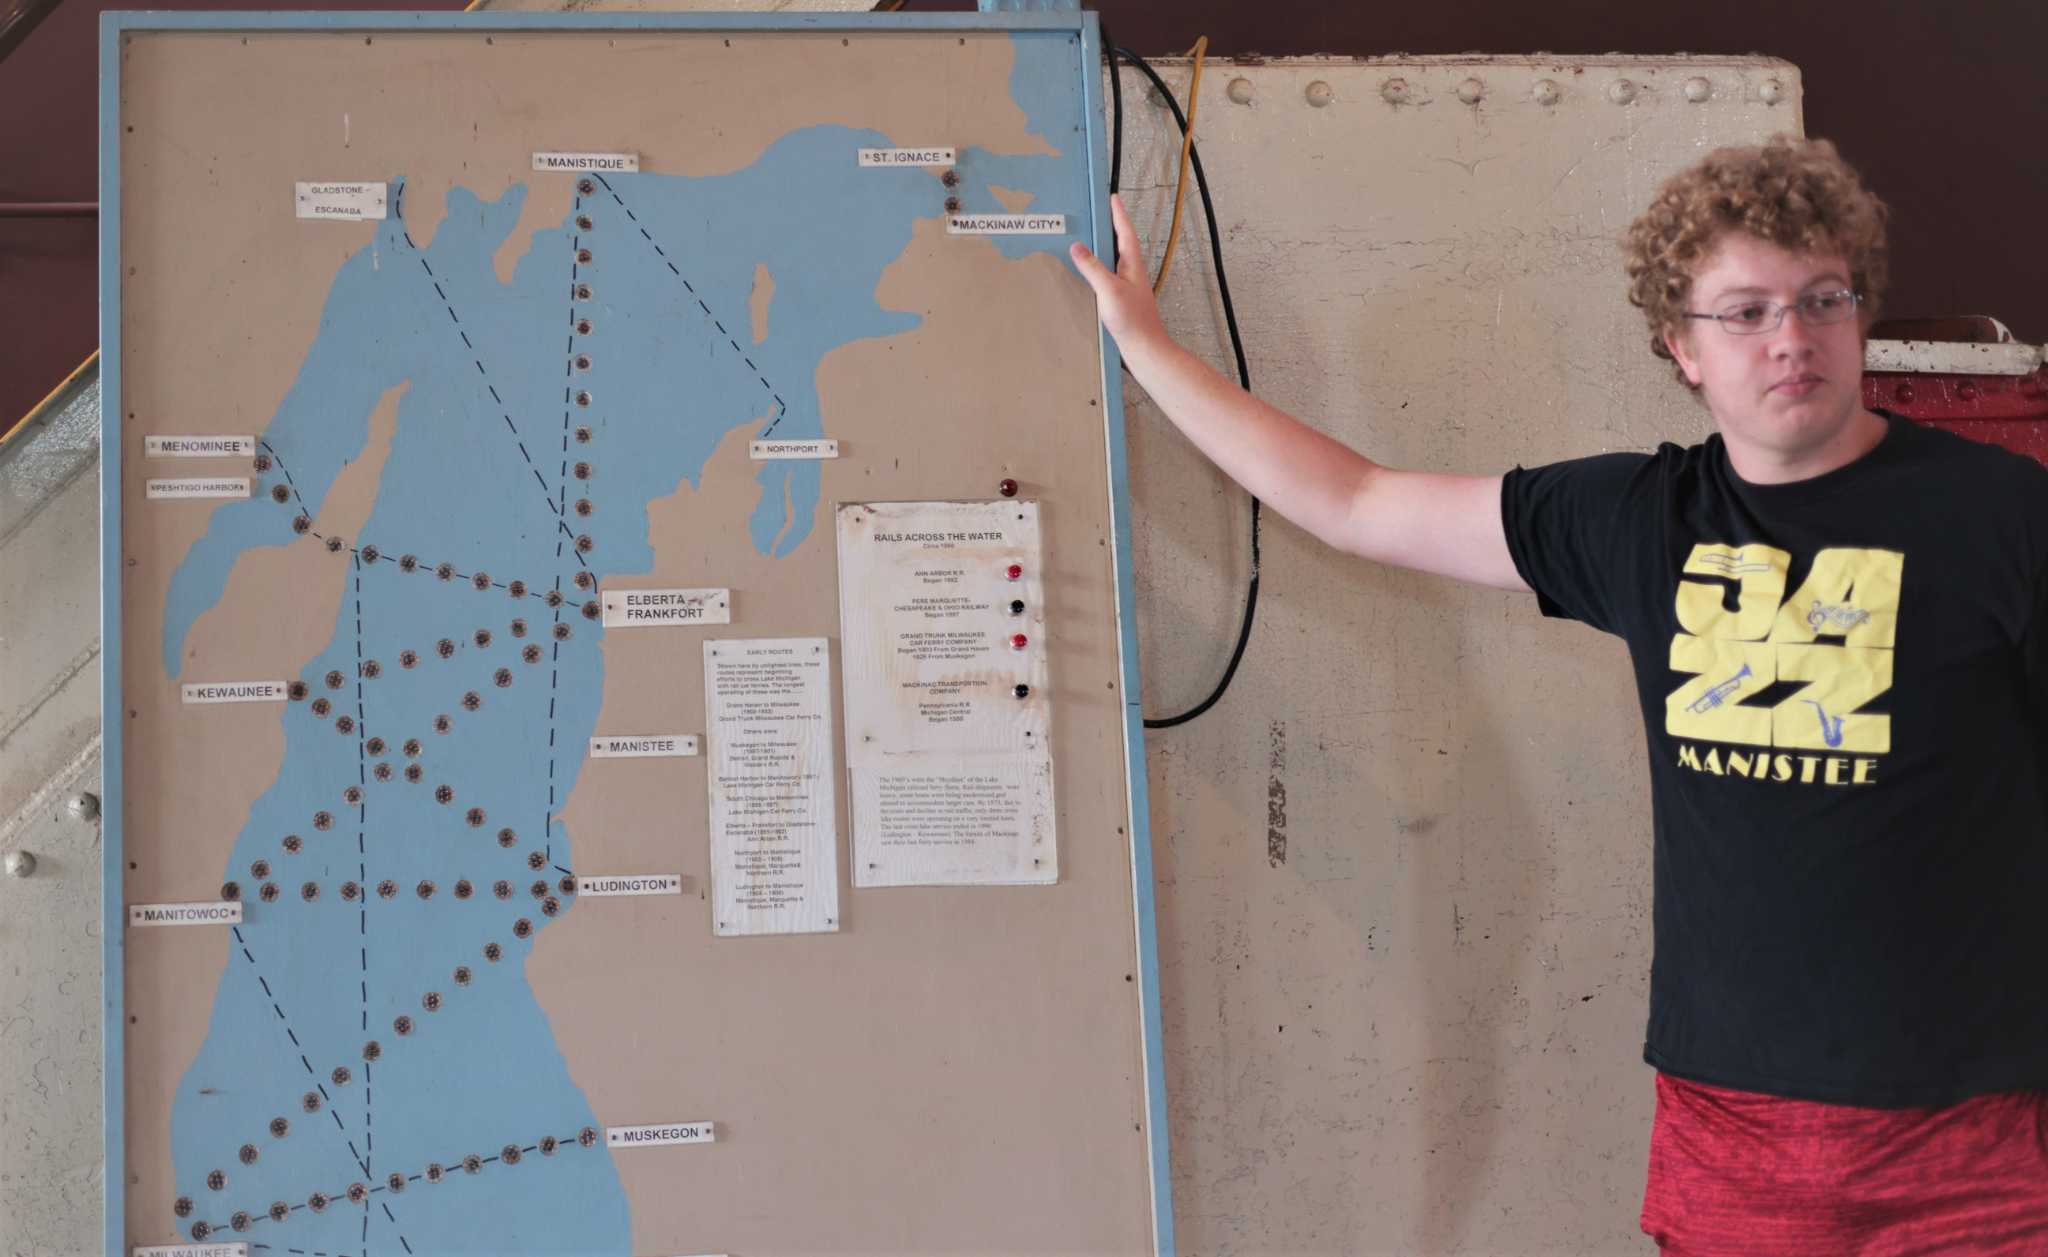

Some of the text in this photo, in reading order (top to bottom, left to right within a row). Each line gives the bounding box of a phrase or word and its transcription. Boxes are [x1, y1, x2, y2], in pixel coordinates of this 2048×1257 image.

[873, 152, 940, 162] ST. IGNACE
[547, 157, 624, 169] MANISTIQUE
[312, 186, 362, 194] GLADSTONE
[960, 219, 1055, 229] MACKINAW CITY
[161, 441, 241, 452] MENOMINEE
[768, 445, 818, 453] NORTHPORT
[874, 532, 1003, 543] RAILS ACROSS THE WATER
[627, 595, 686, 606] ELBERTA
[627, 608, 704, 620] FRANKFORT
[198, 686, 272, 698] KEWAUNEE
[609, 741, 675, 752] MANISTEE
[1677, 744, 1878, 785] MANISTEE
[592, 879, 668, 892] LUDINGTON
[144, 908, 229, 921] MANITOWOC
[624, 1127, 700, 1142] MUSKEGON
